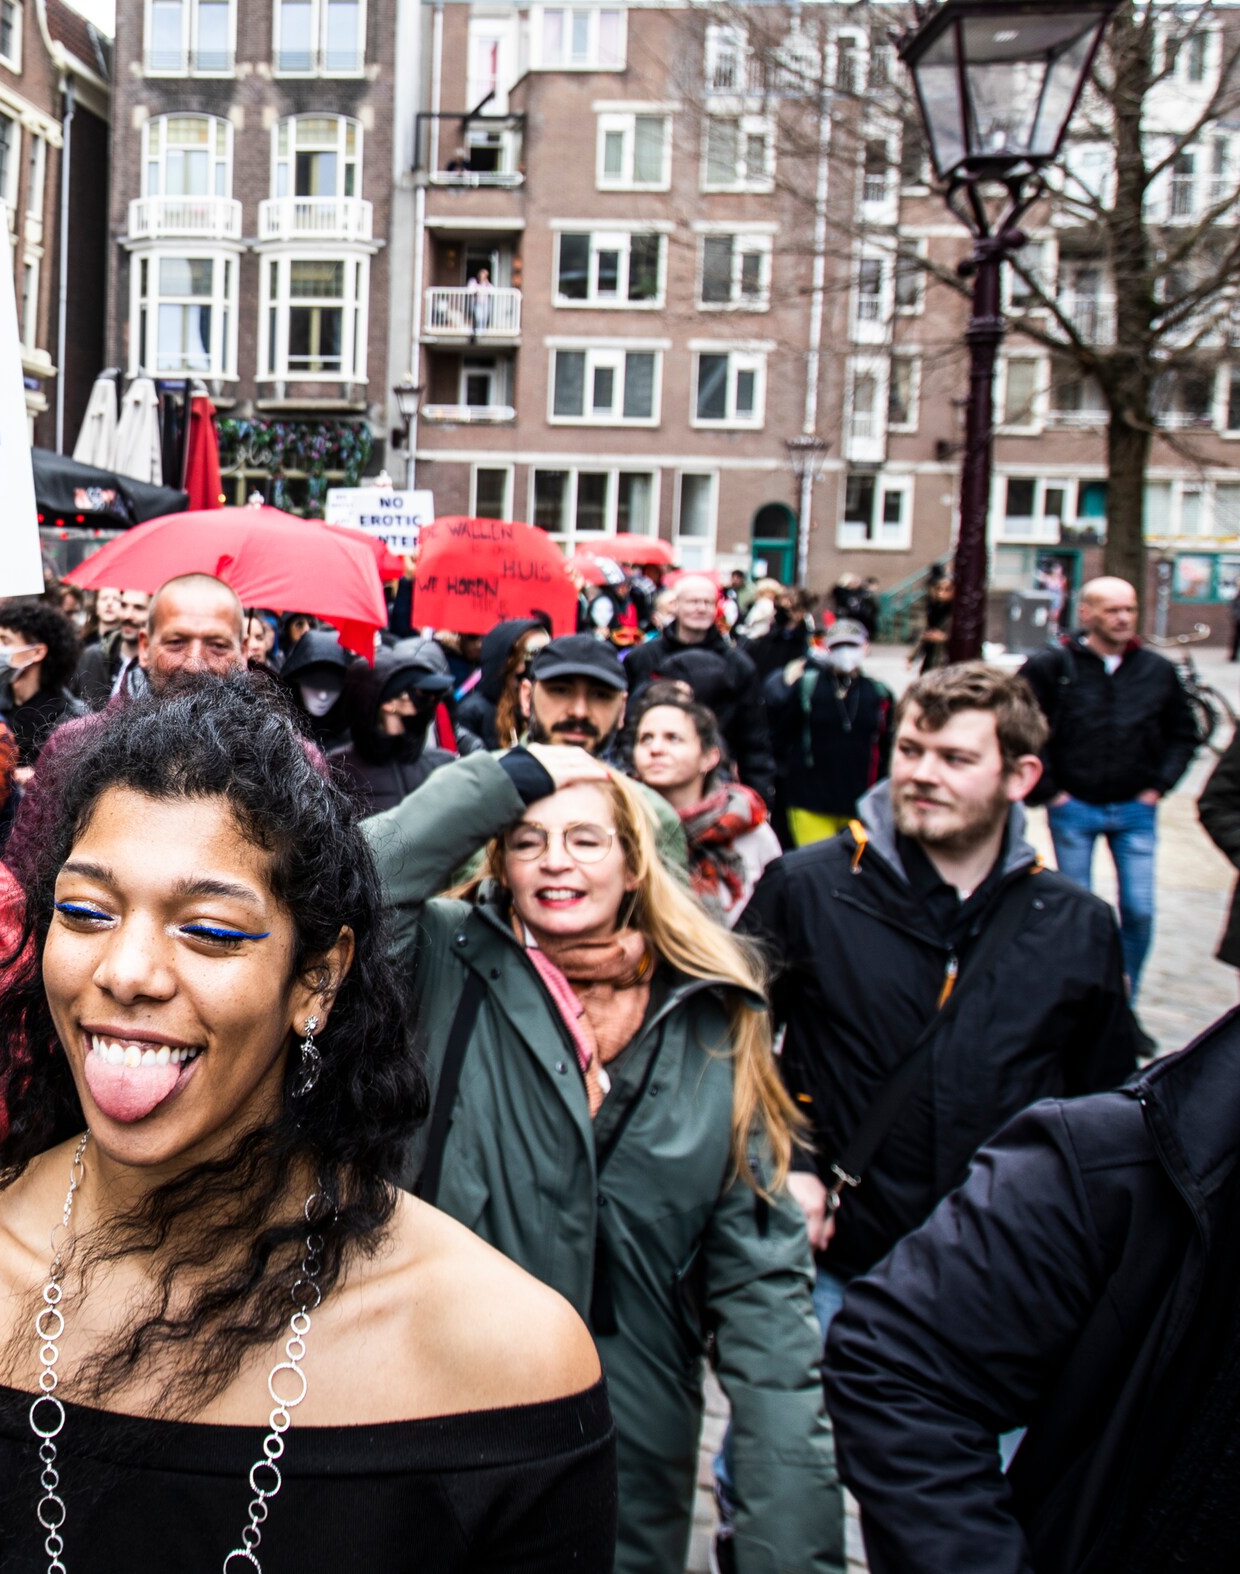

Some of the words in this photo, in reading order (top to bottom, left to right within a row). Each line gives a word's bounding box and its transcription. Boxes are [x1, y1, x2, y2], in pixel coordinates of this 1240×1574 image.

[380, 498, 403, 508] NO
[360, 515, 421, 527] EROTIC
[379, 535, 418, 546] NTE
[502, 559, 552, 582] HUIS
